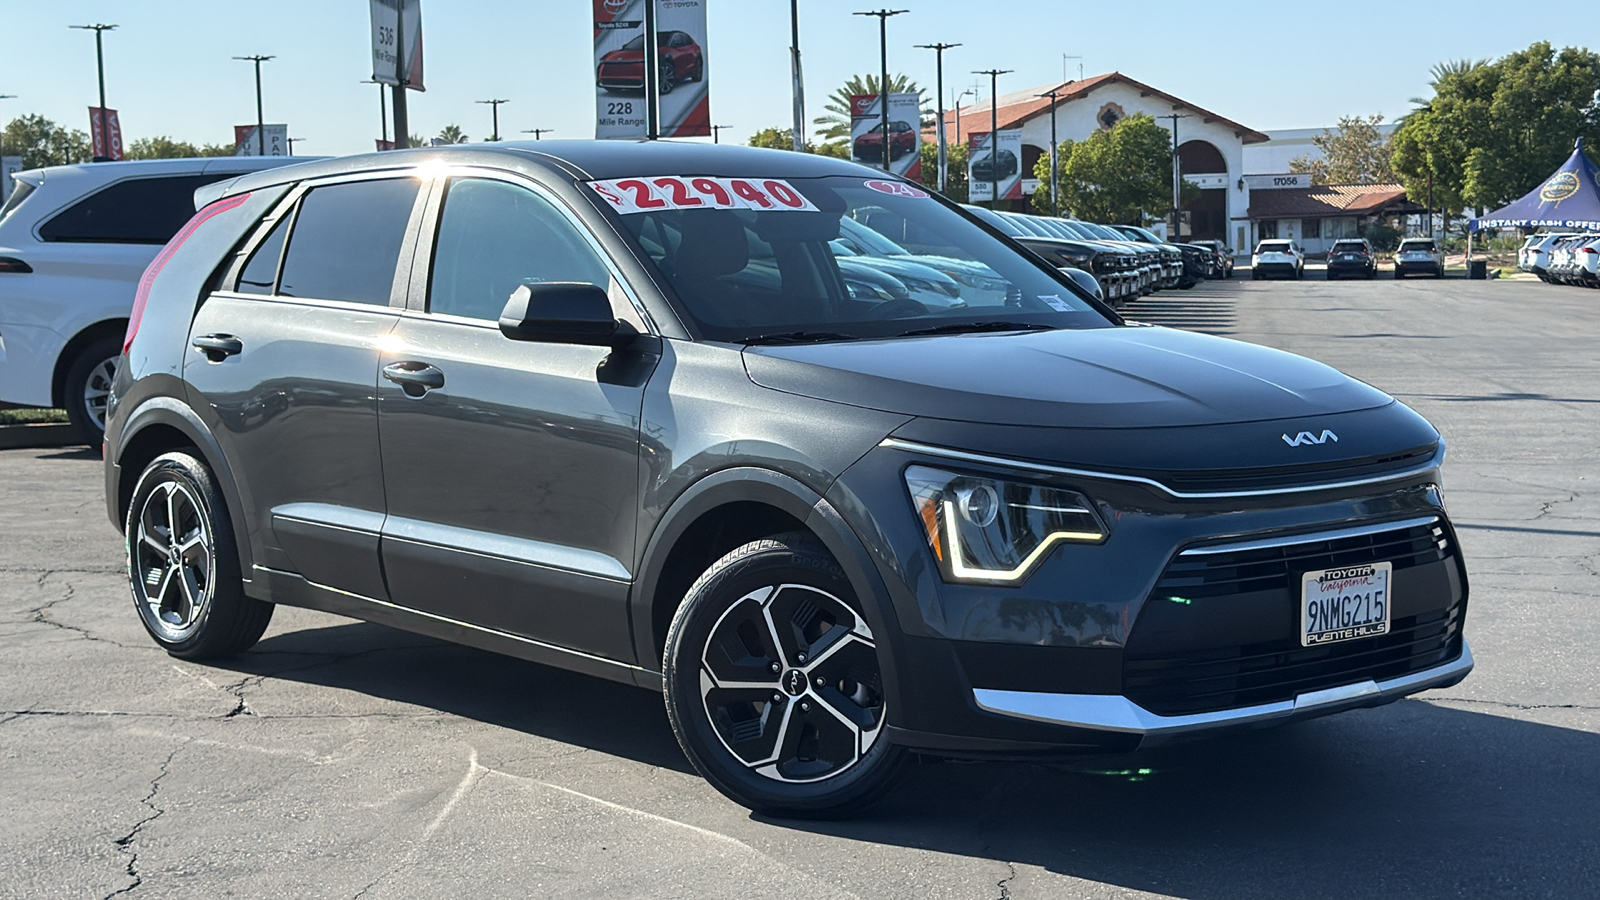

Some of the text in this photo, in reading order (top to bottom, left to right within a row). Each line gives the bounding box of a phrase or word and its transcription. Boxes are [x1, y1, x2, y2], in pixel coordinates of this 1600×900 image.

[598, 22, 615, 30] Toyota
[379, 26, 394, 46] 536
[607, 102, 633, 115] 228
[598, 118, 645, 127] Mile Range
[109, 114, 121, 160] YOTA
[1273, 177, 1298, 186] 17056
[881, 182, 915, 197] 24
[1478, 219, 1527, 229] INSTANT
[1282, 429, 1338, 447] KIA
[1325, 566, 1371, 580] TOYOTA
[1321, 576, 1374, 594] California
[1308, 591, 1384, 632] 9NMG215
[1354, 623, 1385, 637] HILLS
